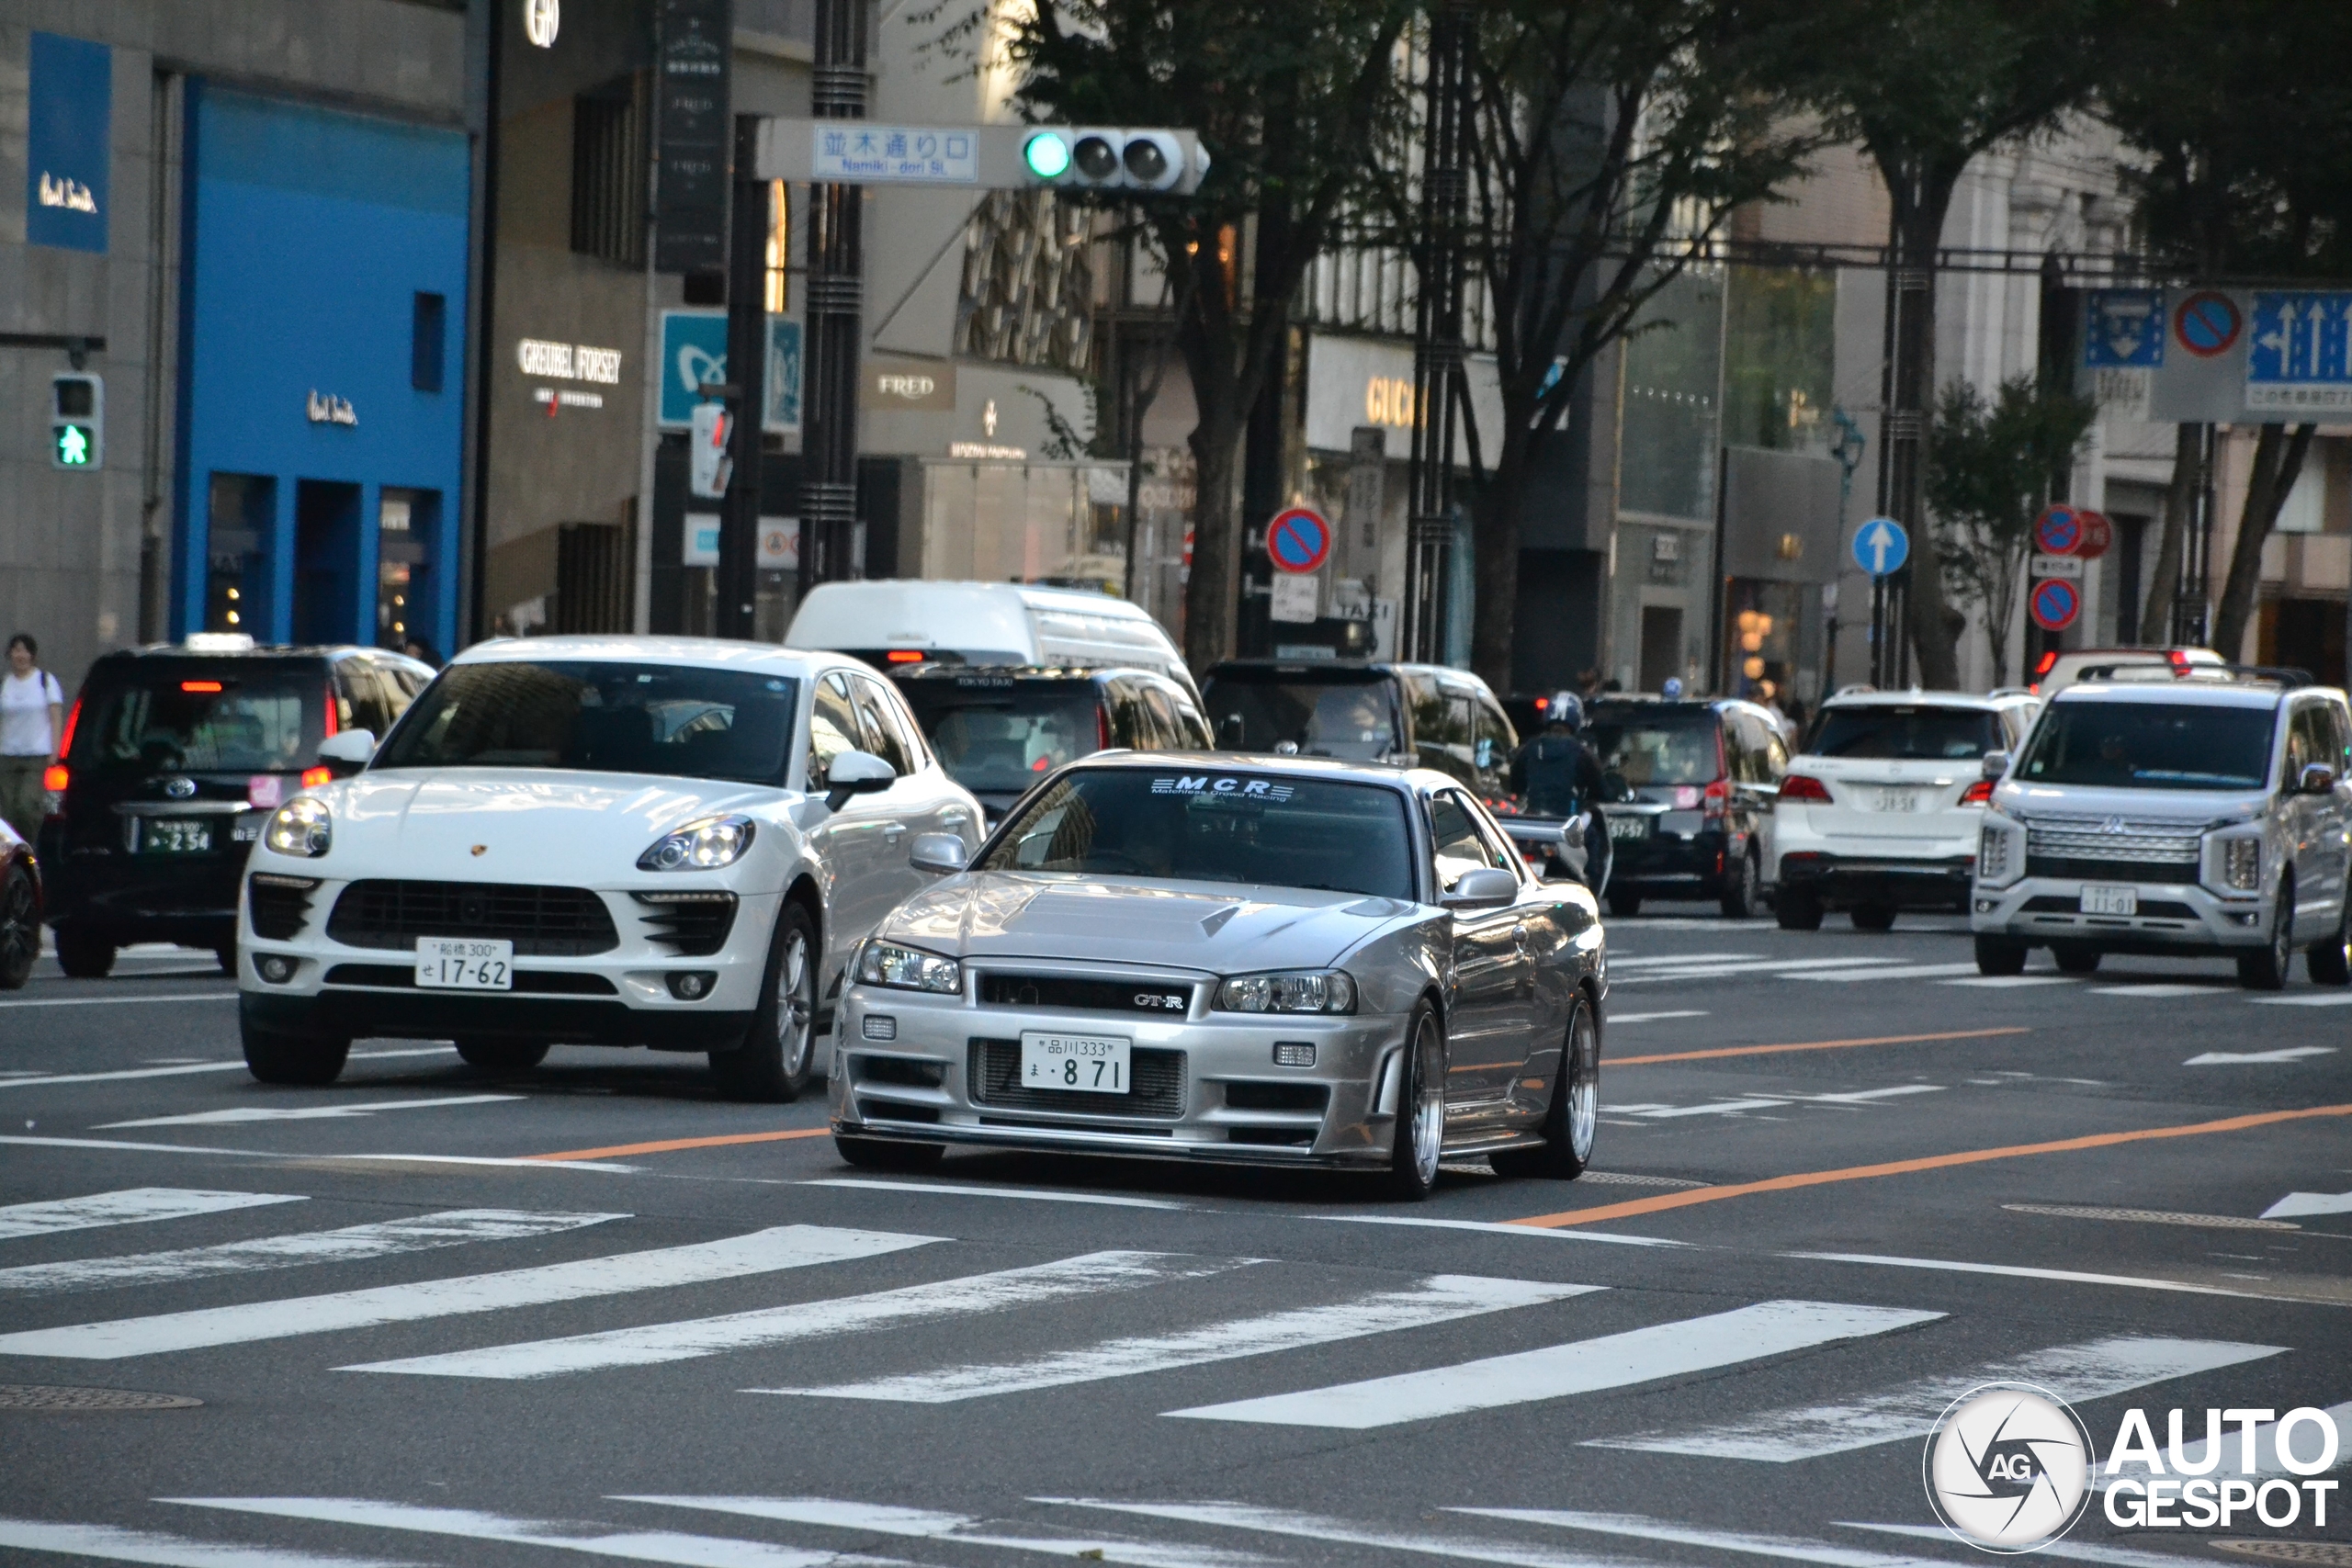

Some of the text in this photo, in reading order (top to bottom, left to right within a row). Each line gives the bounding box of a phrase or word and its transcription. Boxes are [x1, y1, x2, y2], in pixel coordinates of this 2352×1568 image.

[825, 131, 968, 160] 並木通り口
[518, 338, 622, 384] GREUBEL FORSEY
[878, 375, 934, 399] FRED
[958, 678, 1013, 687] TOKYO TAXI
[1151, 787, 1206, 795] Matchless
[1249, 794, 1287, 803] Racing
[440, 942, 492, 956] 船橋 300
[423, 958, 506, 985] せ 17-62
[1134, 993, 1183, 1010] GT-R
[1030, 1063, 1039, 1077] ま
